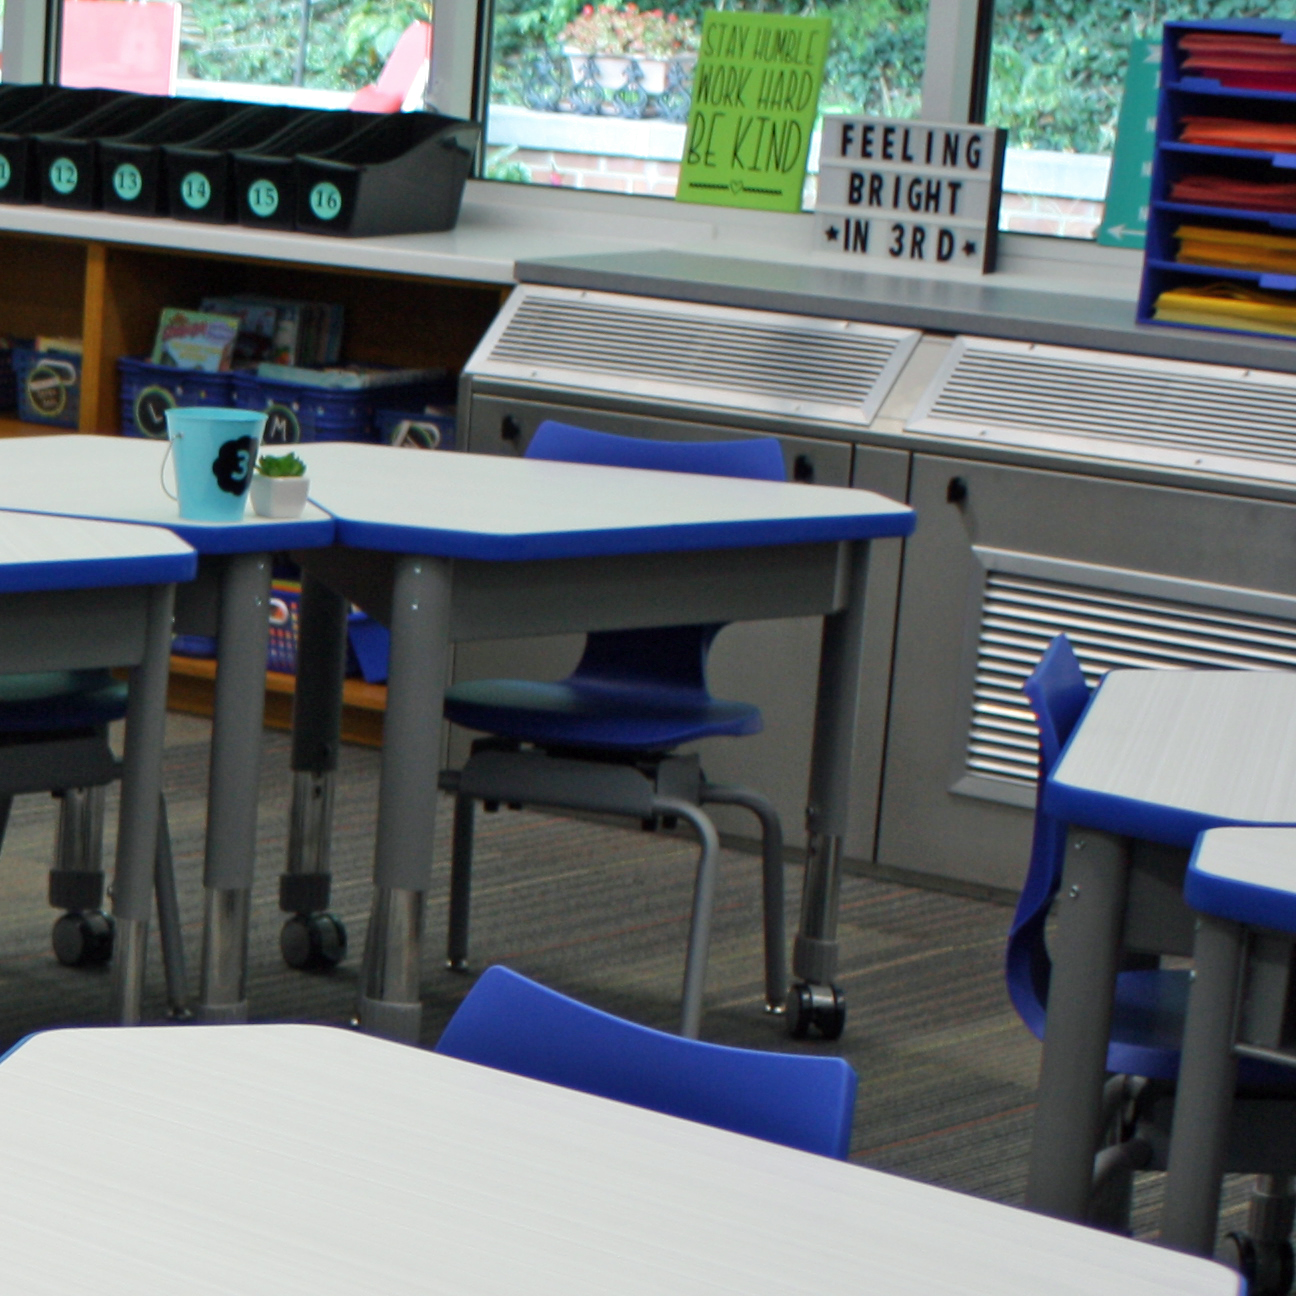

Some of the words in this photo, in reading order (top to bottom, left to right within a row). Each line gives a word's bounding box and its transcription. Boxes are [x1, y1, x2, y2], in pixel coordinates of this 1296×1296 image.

[706, 22, 750, 60] STAY
[753, 27, 820, 66] HUMBLE
[697, 63, 753, 108] WORK
[758, 69, 813, 112] HARD
[687, 110, 726, 167] BE
[731, 115, 802, 174] KIND
[841, 123, 982, 169] FEELING
[56, 166, 76, 184] 12
[118, 172, 138, 189] 13
[186, 180, 206, 198] 14
[253, 188, 275, 206] 15
[316, 190, 337, 209] 16
[848, 172, 962, 215] BRIGHT
[843, 218, 869, 254] IN
[889, 223, 955, 262] 3RD
[271, 416, 288, 441] M
[230, 449, 250, 481] 3
